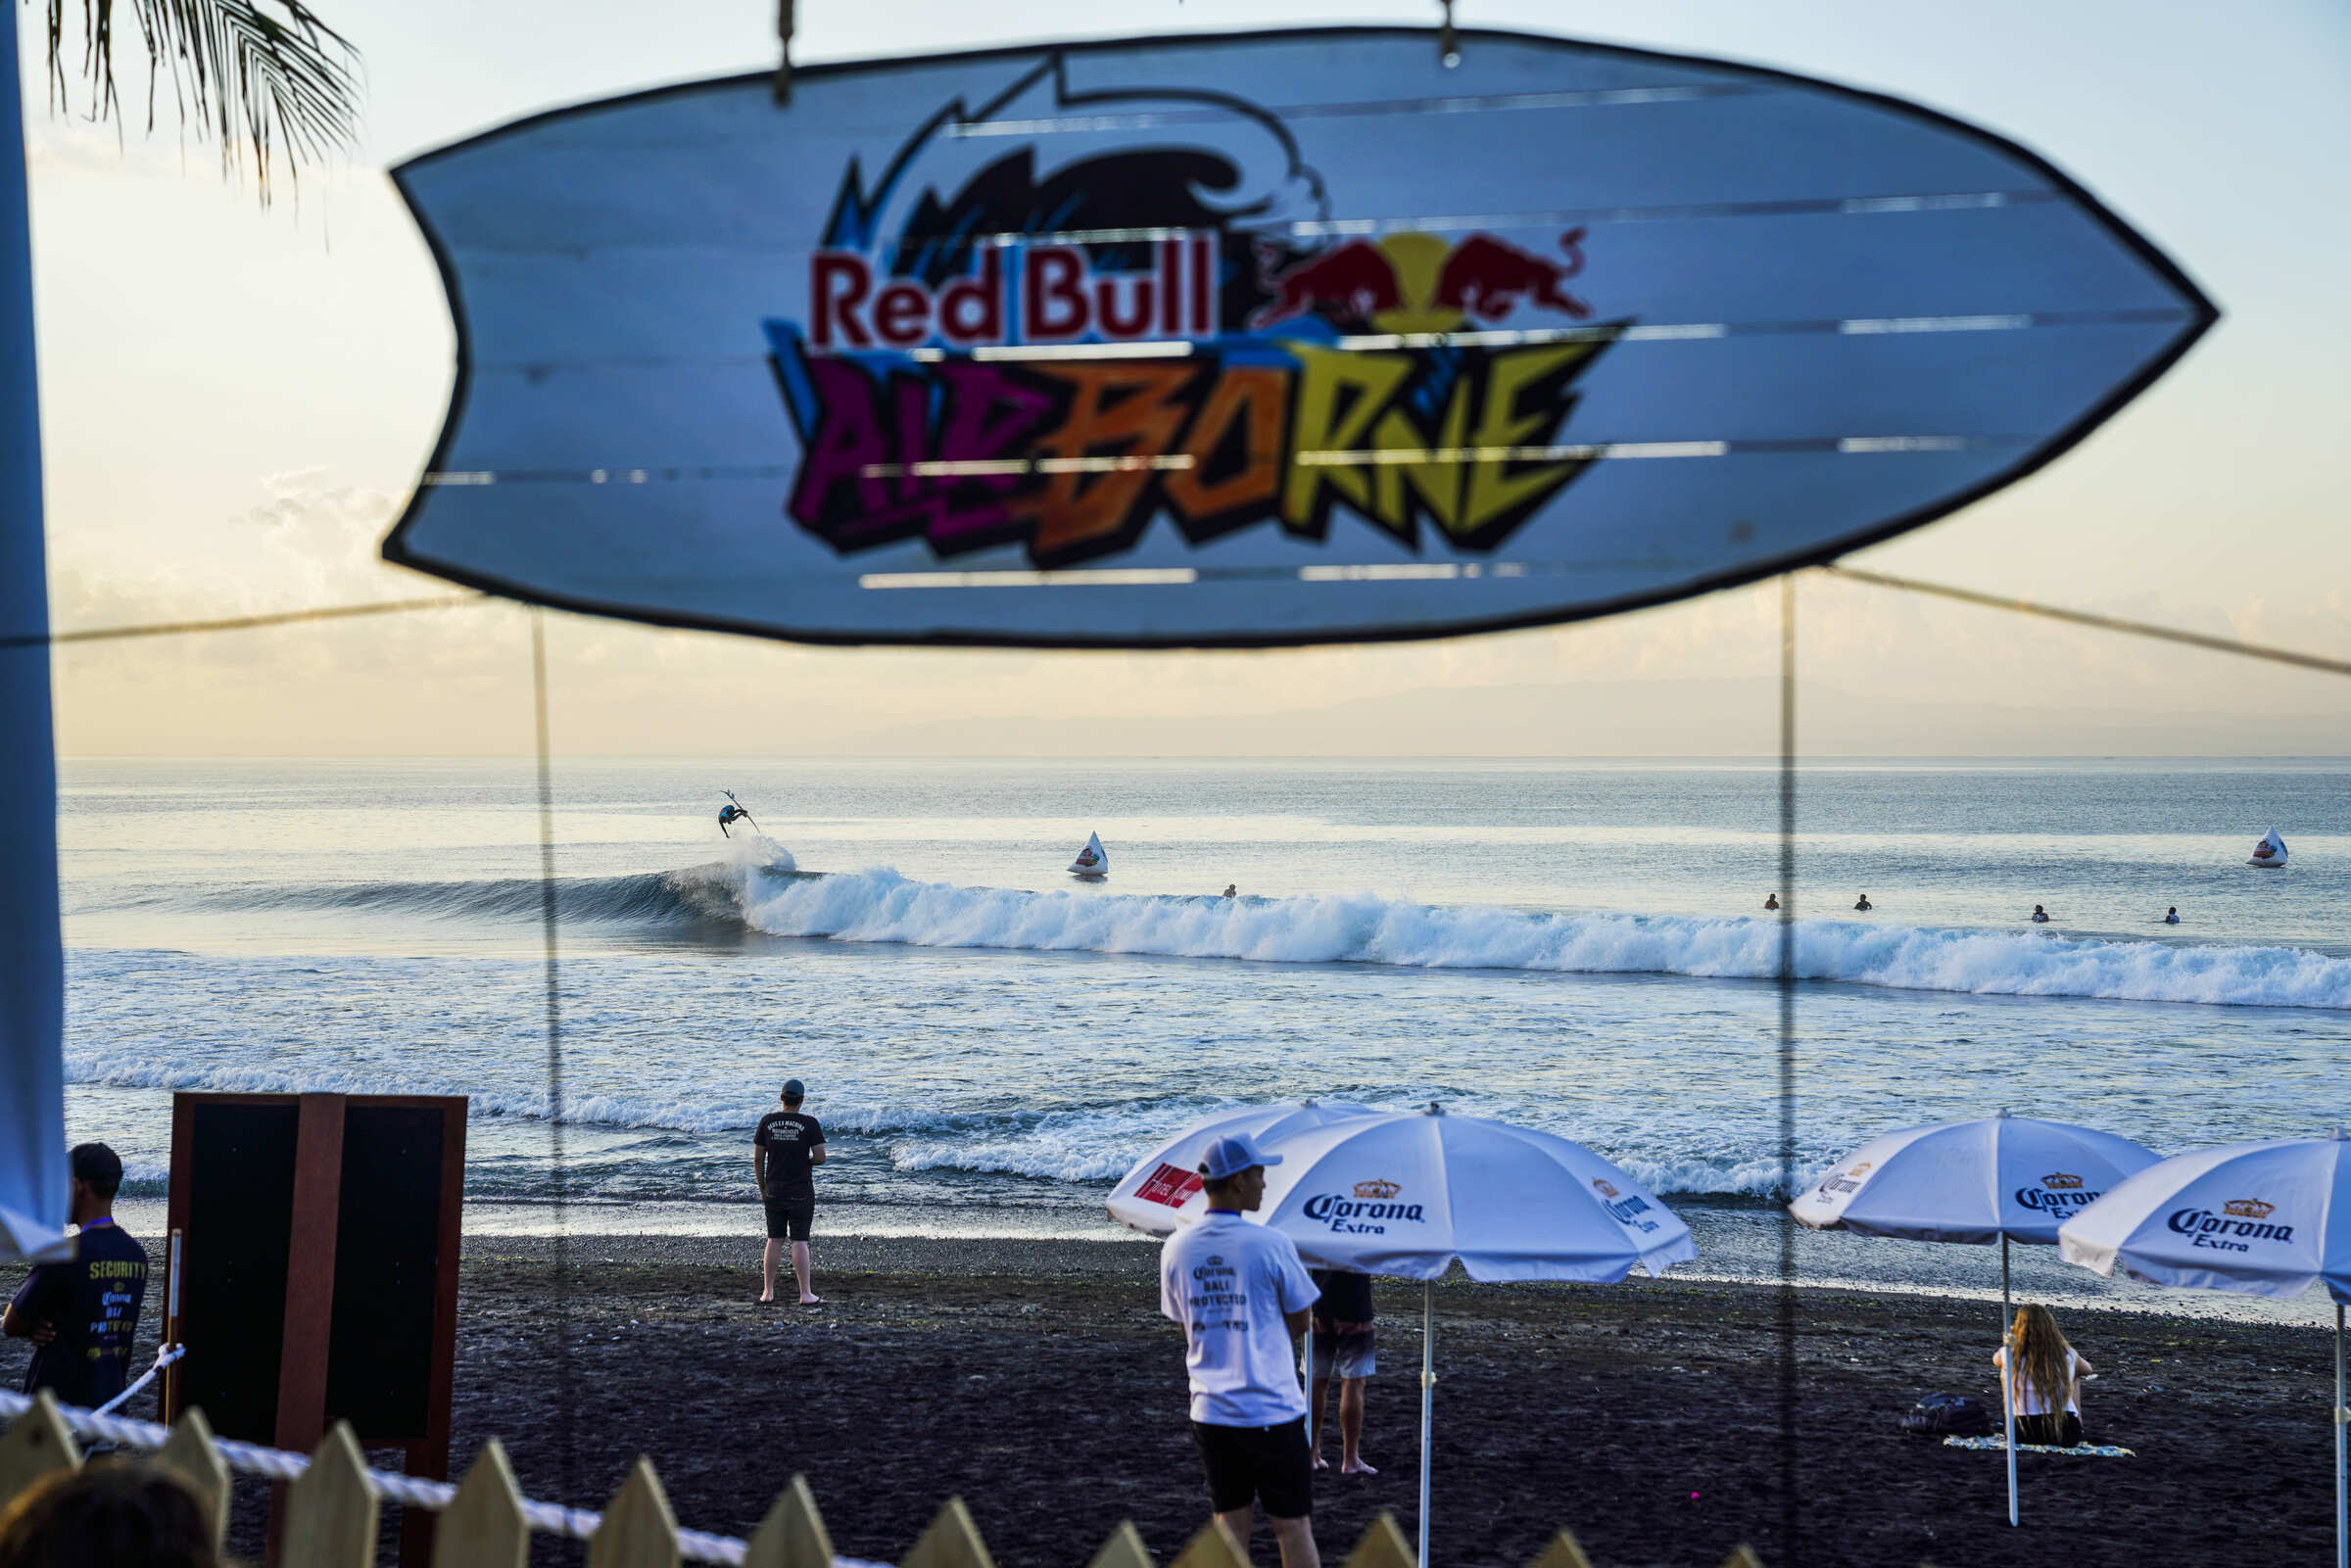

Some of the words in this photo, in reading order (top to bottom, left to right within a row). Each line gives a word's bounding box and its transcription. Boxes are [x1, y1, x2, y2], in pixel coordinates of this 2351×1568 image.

[811, 243, 1002, 350] Red
[1025, 233, 1217, 341] Bull
[789, 335, 1624, 560] AIRBORNE
[1303, 1194, 1424, 1223] Corona
[2015, 1188, 2101, 1212] Coron
[1331, 1218, 1385, 1235] Extra
[2168, 1208, 2294, 1243] Corona
[2193, 1233, 2250, 1253] Extra
[89, 1260, 147, 1280] SECURITY
[1204, 1280, 1229, 1292] BALI
